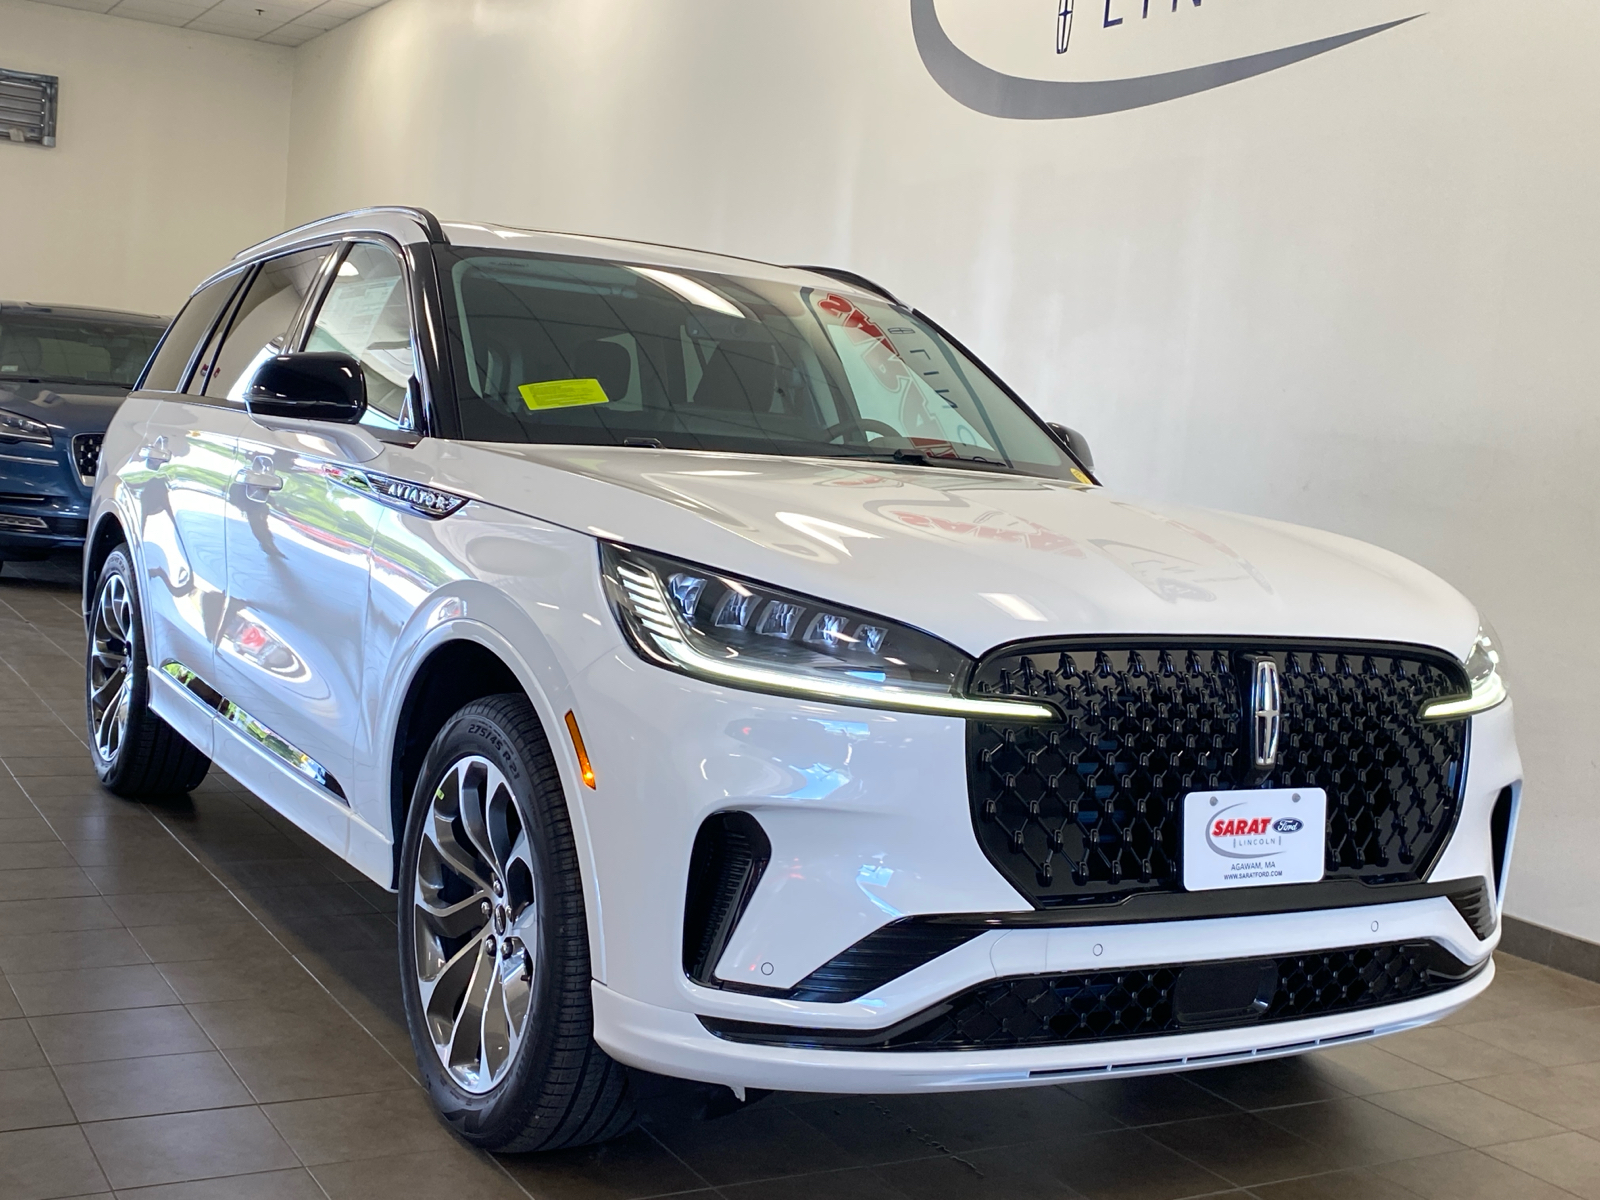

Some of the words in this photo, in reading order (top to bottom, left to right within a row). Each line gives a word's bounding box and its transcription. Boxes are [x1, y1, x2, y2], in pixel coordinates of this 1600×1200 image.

[387, 483, 447, 511] AVIATOR
[468, 723, 503, 751] 275/45
[1212, 817, 1272, 837] SARAT
[1276, 819, 1300, 832] Ford
[1238, 838, 1276, 847] LINCOLN
[1231, 862, 1263, 871] AGAWAM,
[1264, 861, 1276, 869] MA
